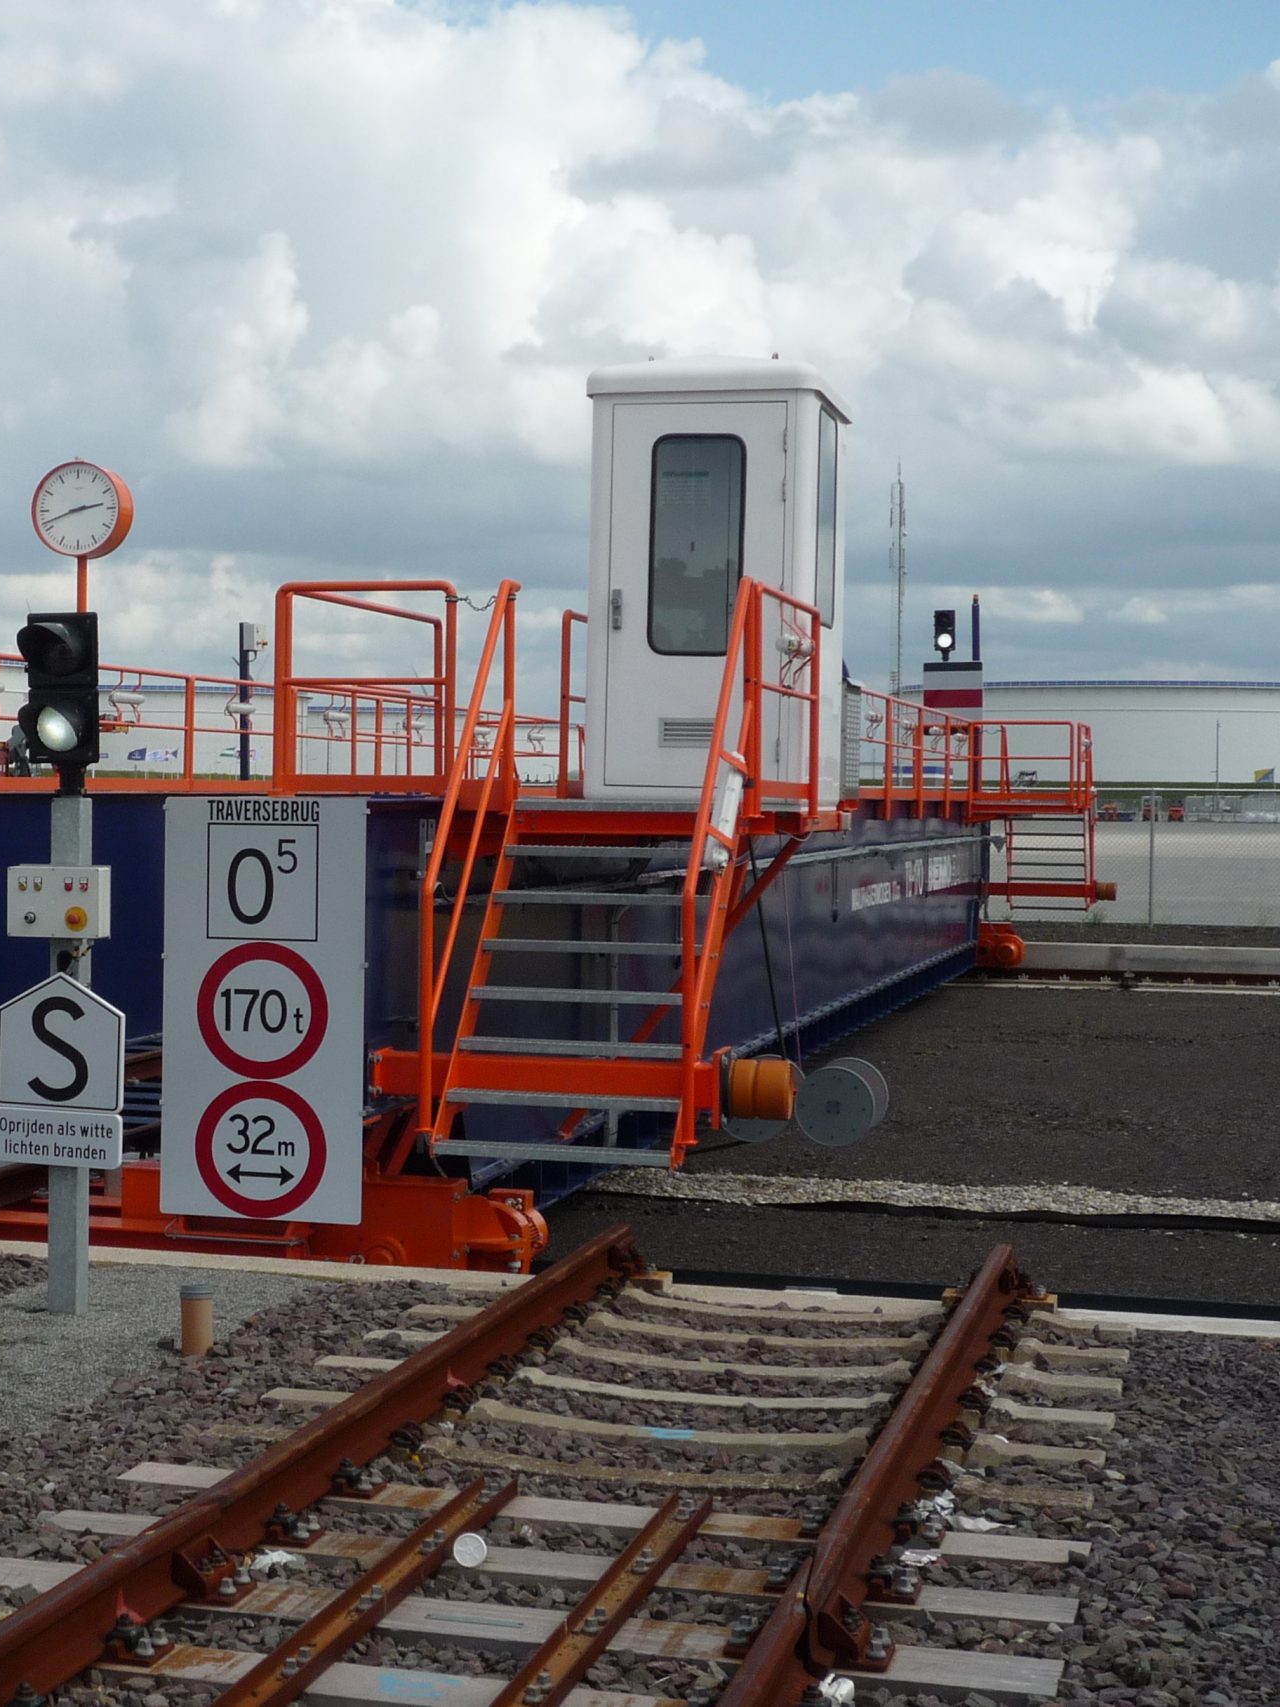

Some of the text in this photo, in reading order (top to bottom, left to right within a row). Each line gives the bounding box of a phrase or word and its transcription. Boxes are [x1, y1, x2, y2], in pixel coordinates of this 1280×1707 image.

[207, 799, 320, 822] TRAVERSEBRUG
[27, 996, 89, 1102] S
[0, 1116, 113, 1139] Oprijden als witte
[4, 1138, 107, 1160] lichten branden
